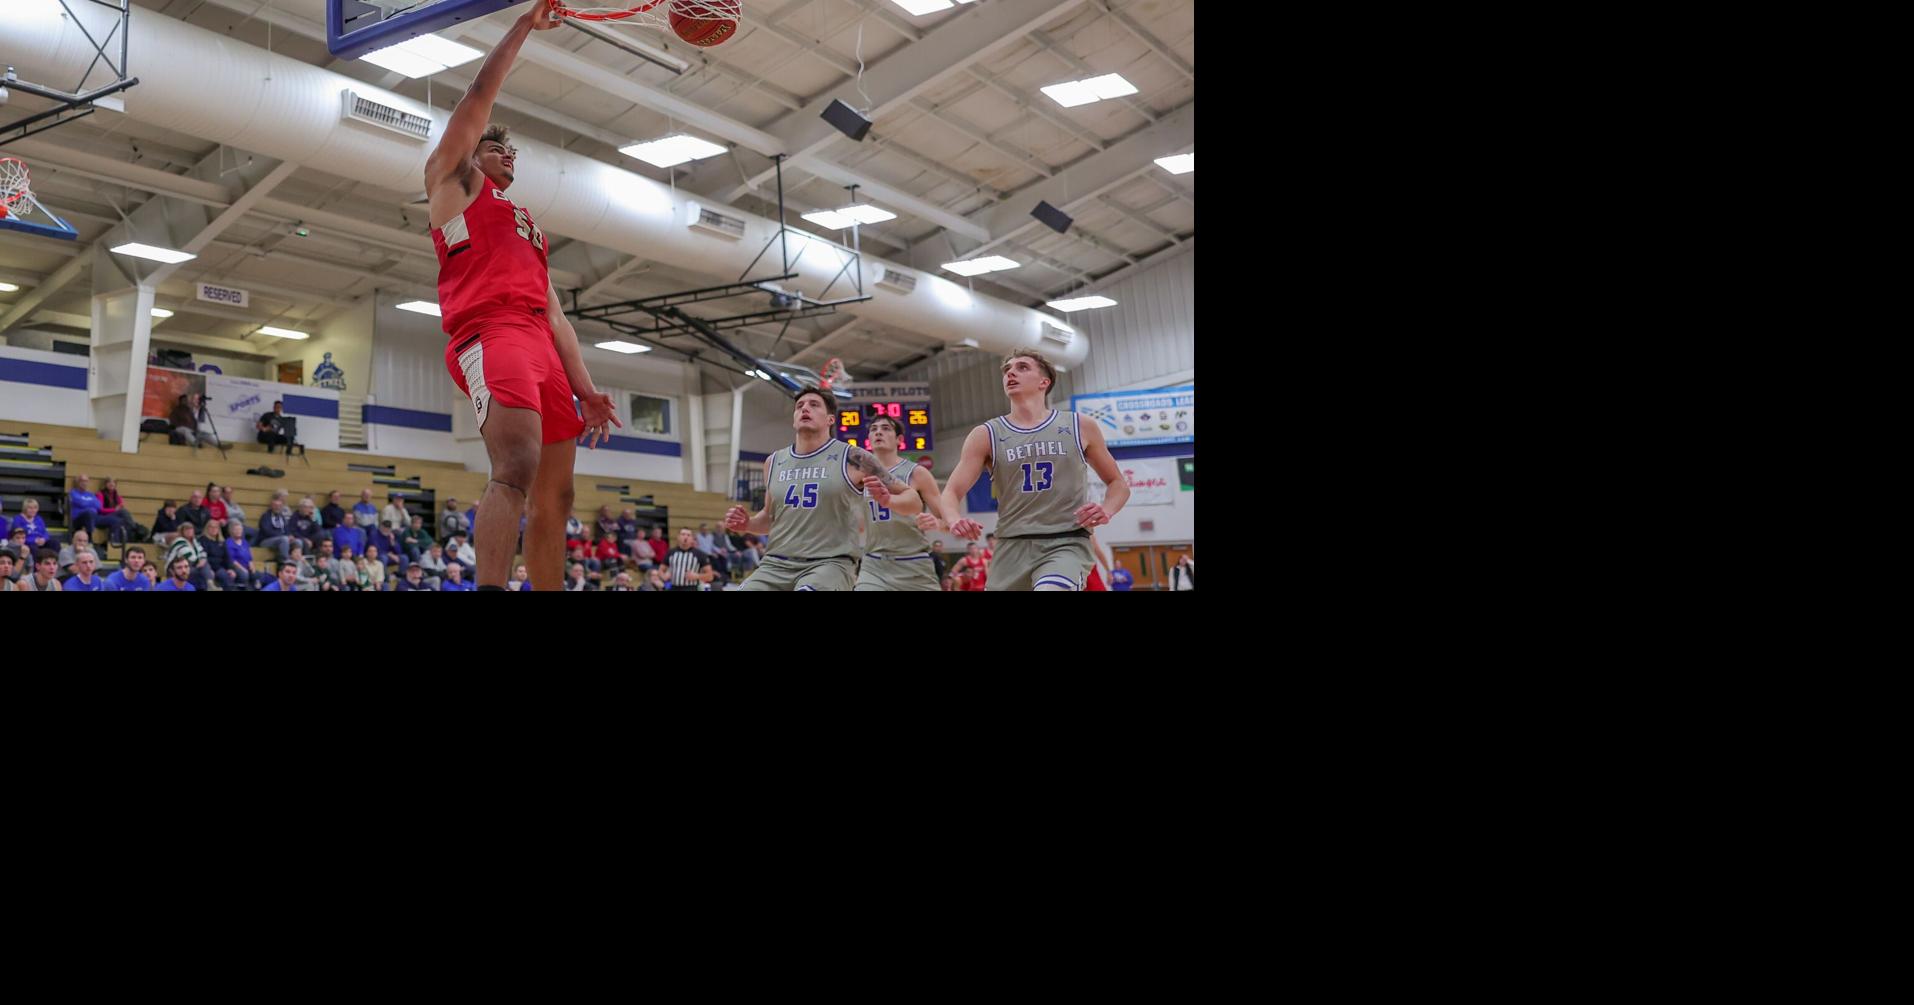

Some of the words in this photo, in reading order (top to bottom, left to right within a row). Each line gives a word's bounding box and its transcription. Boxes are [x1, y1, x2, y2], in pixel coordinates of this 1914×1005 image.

[203, 286, 242, 303] RESERVED
[891, 387, 930, 397] PILOTS
[840, 411, 860, 426] 20
[909, 410, 928, 425] 26
[1006, 441, 1067, 462] BETHEL
[779, 466, 828, 482] BETHEL
[1021, 460, 1054, 493] 13
[784, 482, 820, 509] 45
[868, 499, 892, 523] 15
